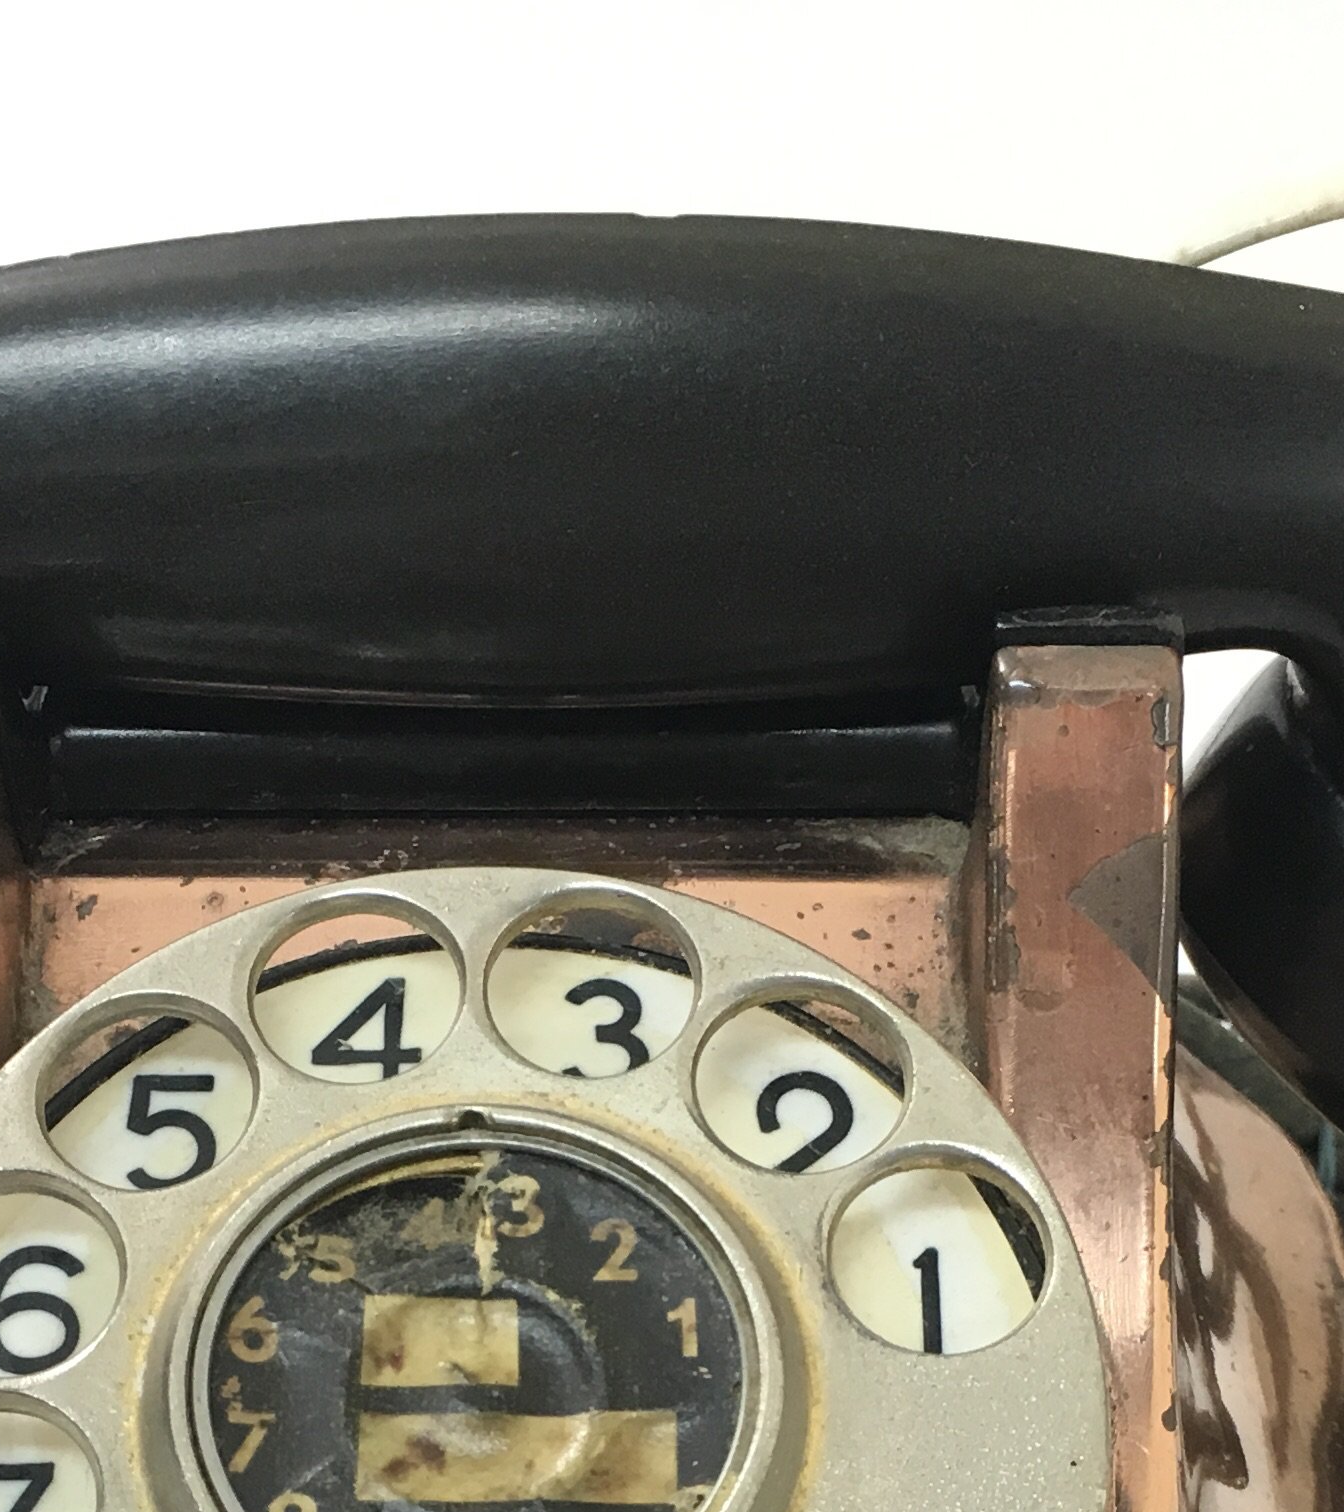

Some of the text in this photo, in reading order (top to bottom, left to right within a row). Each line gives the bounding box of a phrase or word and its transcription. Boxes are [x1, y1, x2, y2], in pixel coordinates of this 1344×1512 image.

[311, 977, 423, 1080] 4
[562, 978, 650, 1077] 3
[126, 1074, 217, 1190] 5
[756, 1070, 854, 1173] 2
[498, 1174, 545, 1237] 3
[590, 1219, 638, 1281] 2
[227, 1296, 279, 1364] 6
[667, 1298, 699, 1357] 1
[912, 1246, 945, 1356] 1
[227, 1408, 277, 1473] 7
